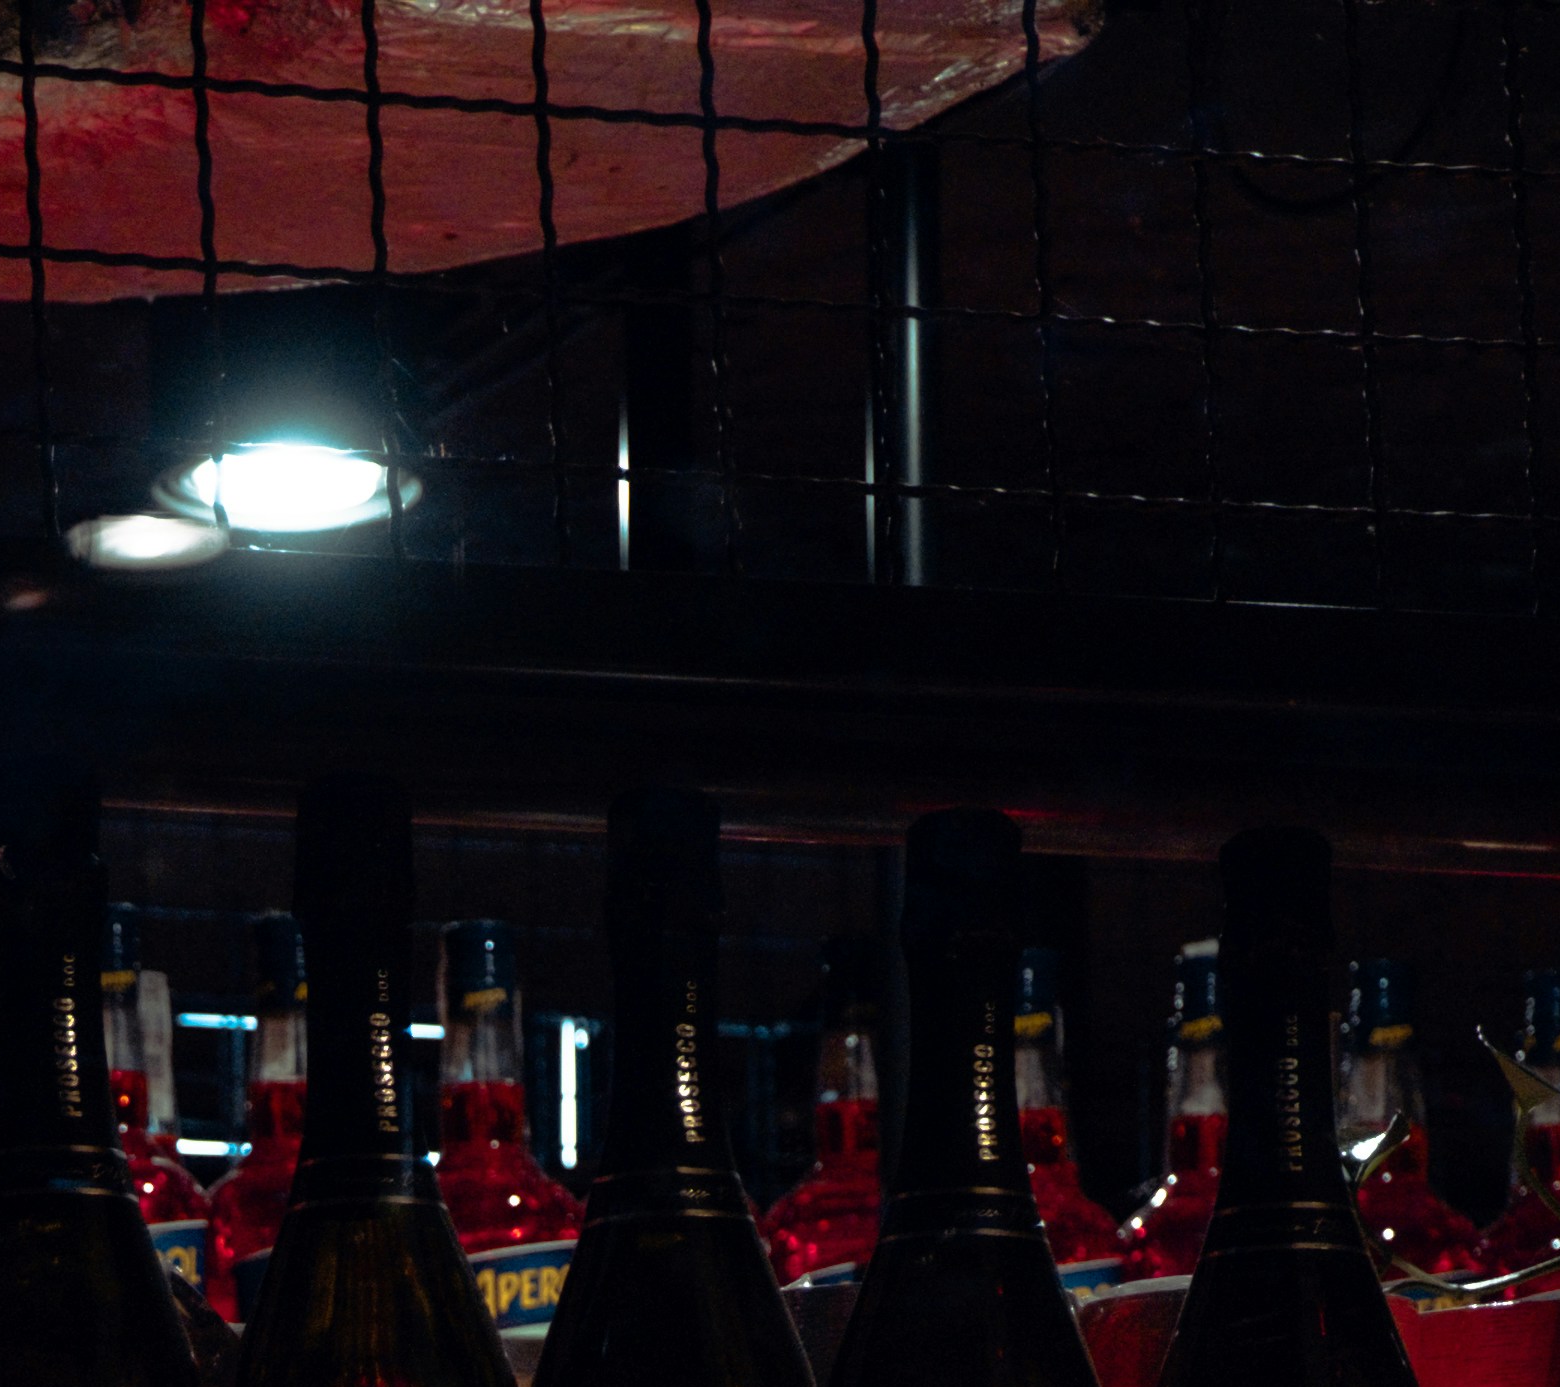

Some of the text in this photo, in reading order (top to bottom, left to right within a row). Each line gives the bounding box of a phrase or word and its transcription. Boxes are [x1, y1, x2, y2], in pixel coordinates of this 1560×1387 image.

[57, 996, 82, 1118] PROSECCO
[374, 1011, 400, 1133] PROSECCO
[675, 1022, 703, 1143] PROSECCO
[972, 1043, 1001, 1162] PROSECCO
[1279, 1056, 1304, 1174] PROSECCO
